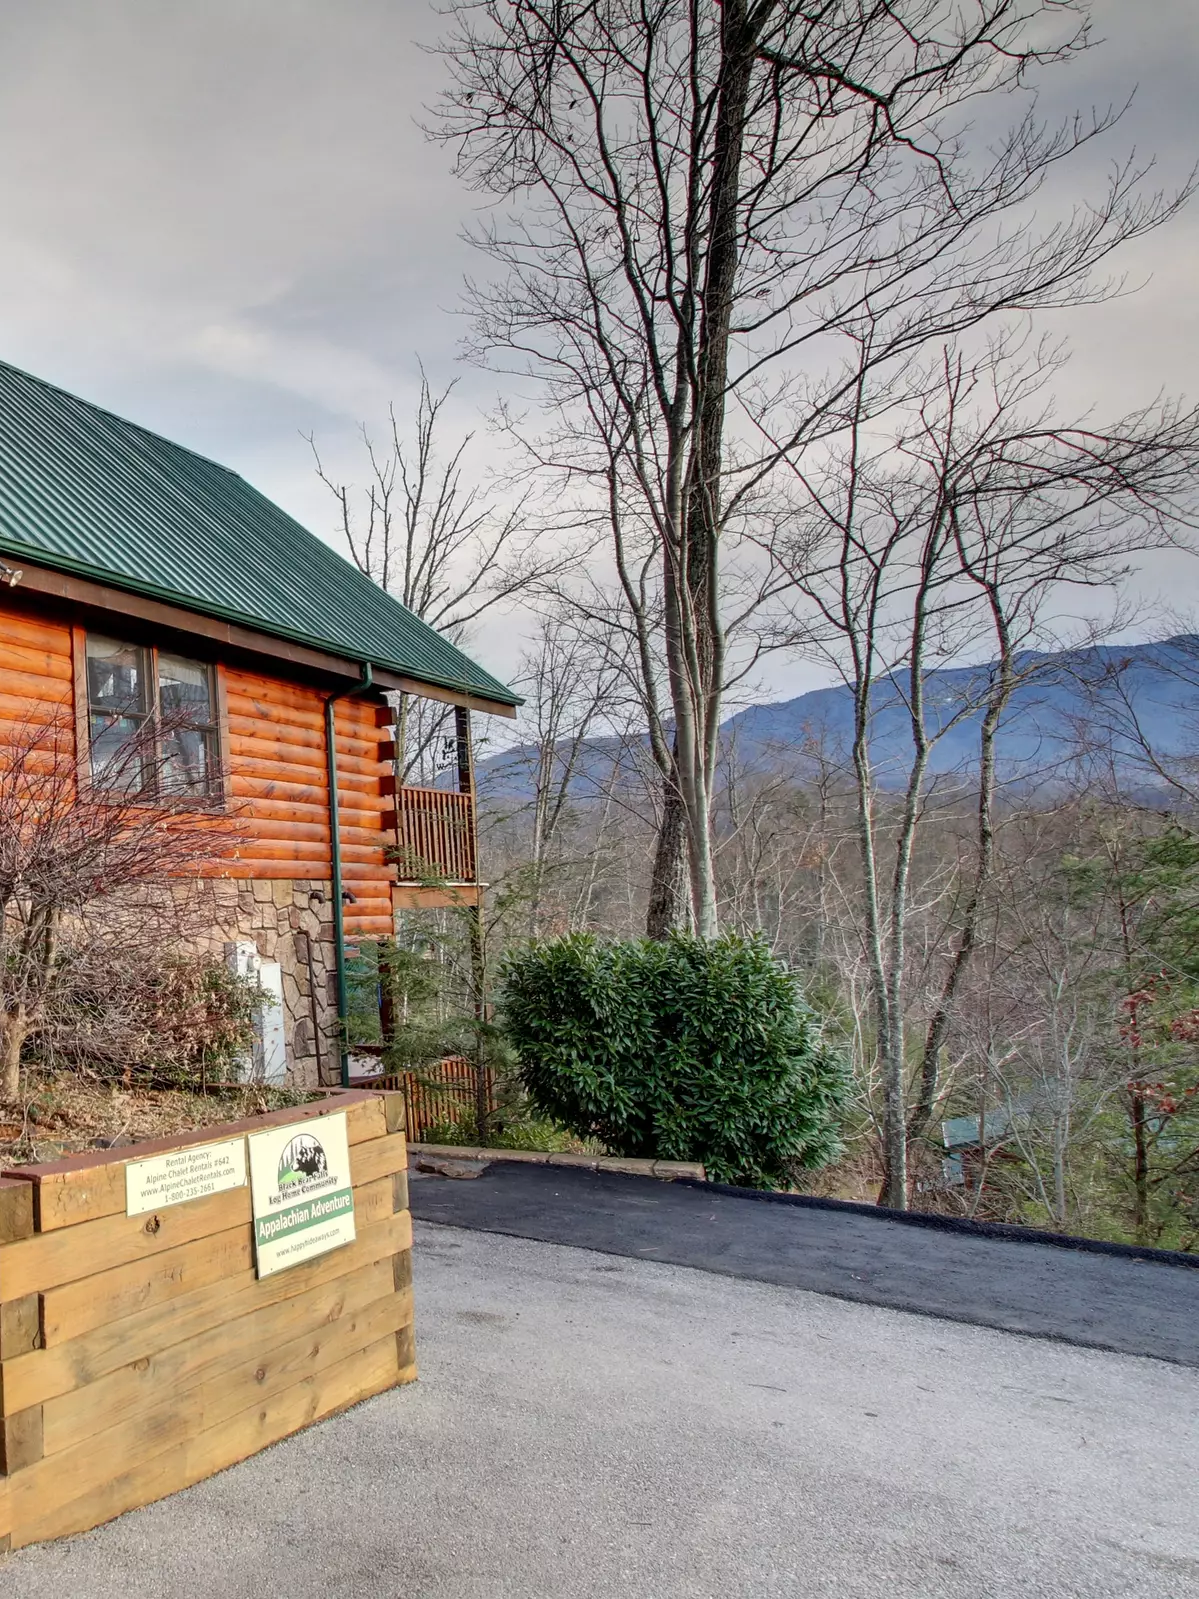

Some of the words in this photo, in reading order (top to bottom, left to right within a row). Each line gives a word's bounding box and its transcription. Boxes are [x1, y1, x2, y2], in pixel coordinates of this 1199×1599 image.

[146, 1173, 167, 1185] Alpine
[168, 1166, 188, 1179] Chalet
[189, 1161, 212, 1173] Rentals
[166, 1156, 187, 1168] Rental
[187, 1151, 212, 1163] Agency:
[140, 1167, 236, 1198] www.AlpineChaletRentals.com
[268, 1192, 282, 1206] Log
[282, 1186, 301, 1200] Home
[301, 1175, 338, 1194] Community
[278, 1178, 297, 1192] Black
[298, 1174, 311, 1186] Bear
[312, 1170, 329, 1181] Falls
[259, 1207, 310, 1239] Appalachian
[311, 1193, 350, 1219] Adventure
[276, 1228, 340, 1258] www.happyhideaways.com
